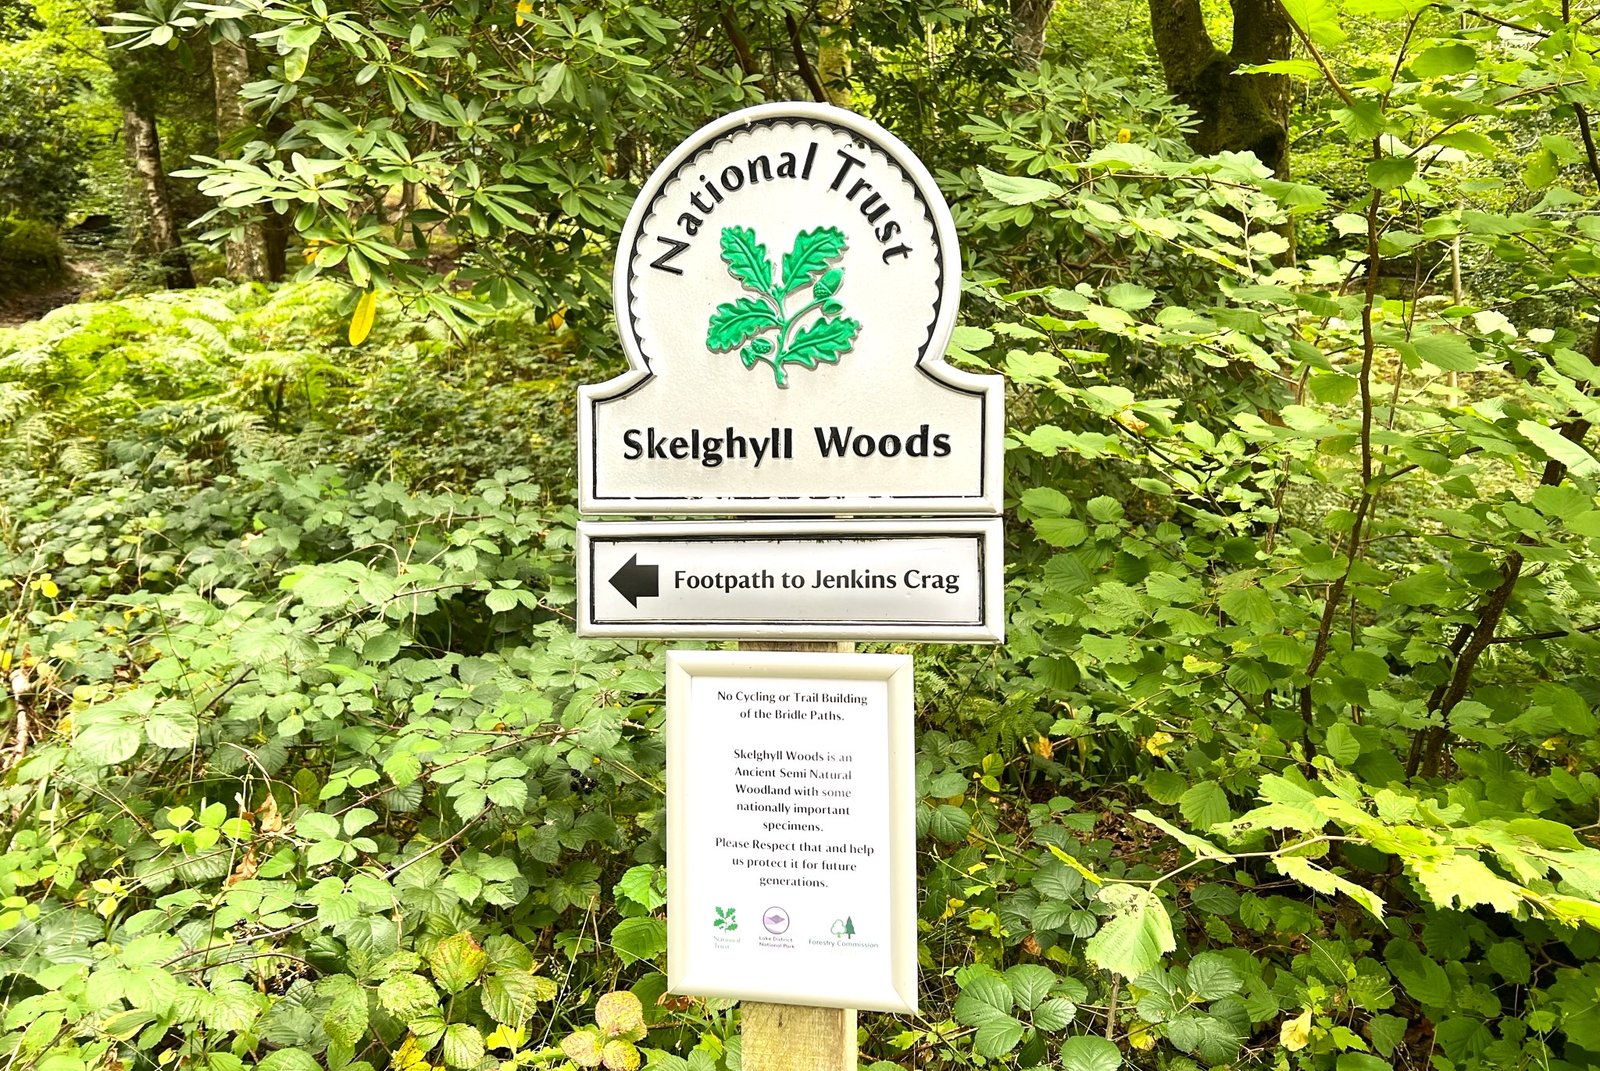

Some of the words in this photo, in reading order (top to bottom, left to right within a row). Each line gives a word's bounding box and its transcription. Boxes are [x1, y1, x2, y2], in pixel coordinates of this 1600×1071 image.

[650, 142, 818, 275] National
[827, 148, 914, 266] Trust
[624, 427, 793, 467] Skelghyll
[814, 424, 952, 458] Woods
[674, 569, 775, 594] Footpath
[782, 572, 805, 589] to
[811, 569, 897, 589] Jenkins
[904, 569, 960, 594] Crag
[717, 691, 733, 701] No
[736, 691, 776, 704] Cycling
[778, 694, 791, 702] or
[794, 692, 819, 703] Trail
[822, 693, 868, 706] Building
[739, 709, 751, 719] of
[754, 709, 772, 719] the
[775, 709, 808, 720] Bridle
[810, 710, 845, 721] Paths.
[733, 749, 783, 762] Skelghyll
[786, 751, 825, 762] Woods
[827, 751, 836, 762] is
[838, 755, 852, 763] an
[734, 767, 776, 778] Ancient
[779, 768, 807, 779] Semi
[809, 769, 852, 780] Natural
[735, 784, 791, 796] Woodland
[794, 786, 819, 797] with
[821, 789, 852, 798] some
[736, 801, 791, 815] nationally
[793, 803, 850, 816] important
[762, 821, 824, 832] specimens.
[715, 837, 750, 849] Please
[752, 839, 796, 852] Respect
[799, 842, 822, 853] that
[825, 843, 847, 854] and
[849, 843, 875, 856] help
[732, 857, 744, 866] us
[747, 858, 787, 870] protect
[790, 859, 799, 869] it
[802, 859, 819, 870] for
[821, 860, 857, 872] future
[759, 876, 828, 888] generations.
[808, 938, 835, 948] Forestry
[837, 940, 879, 949] Commission
